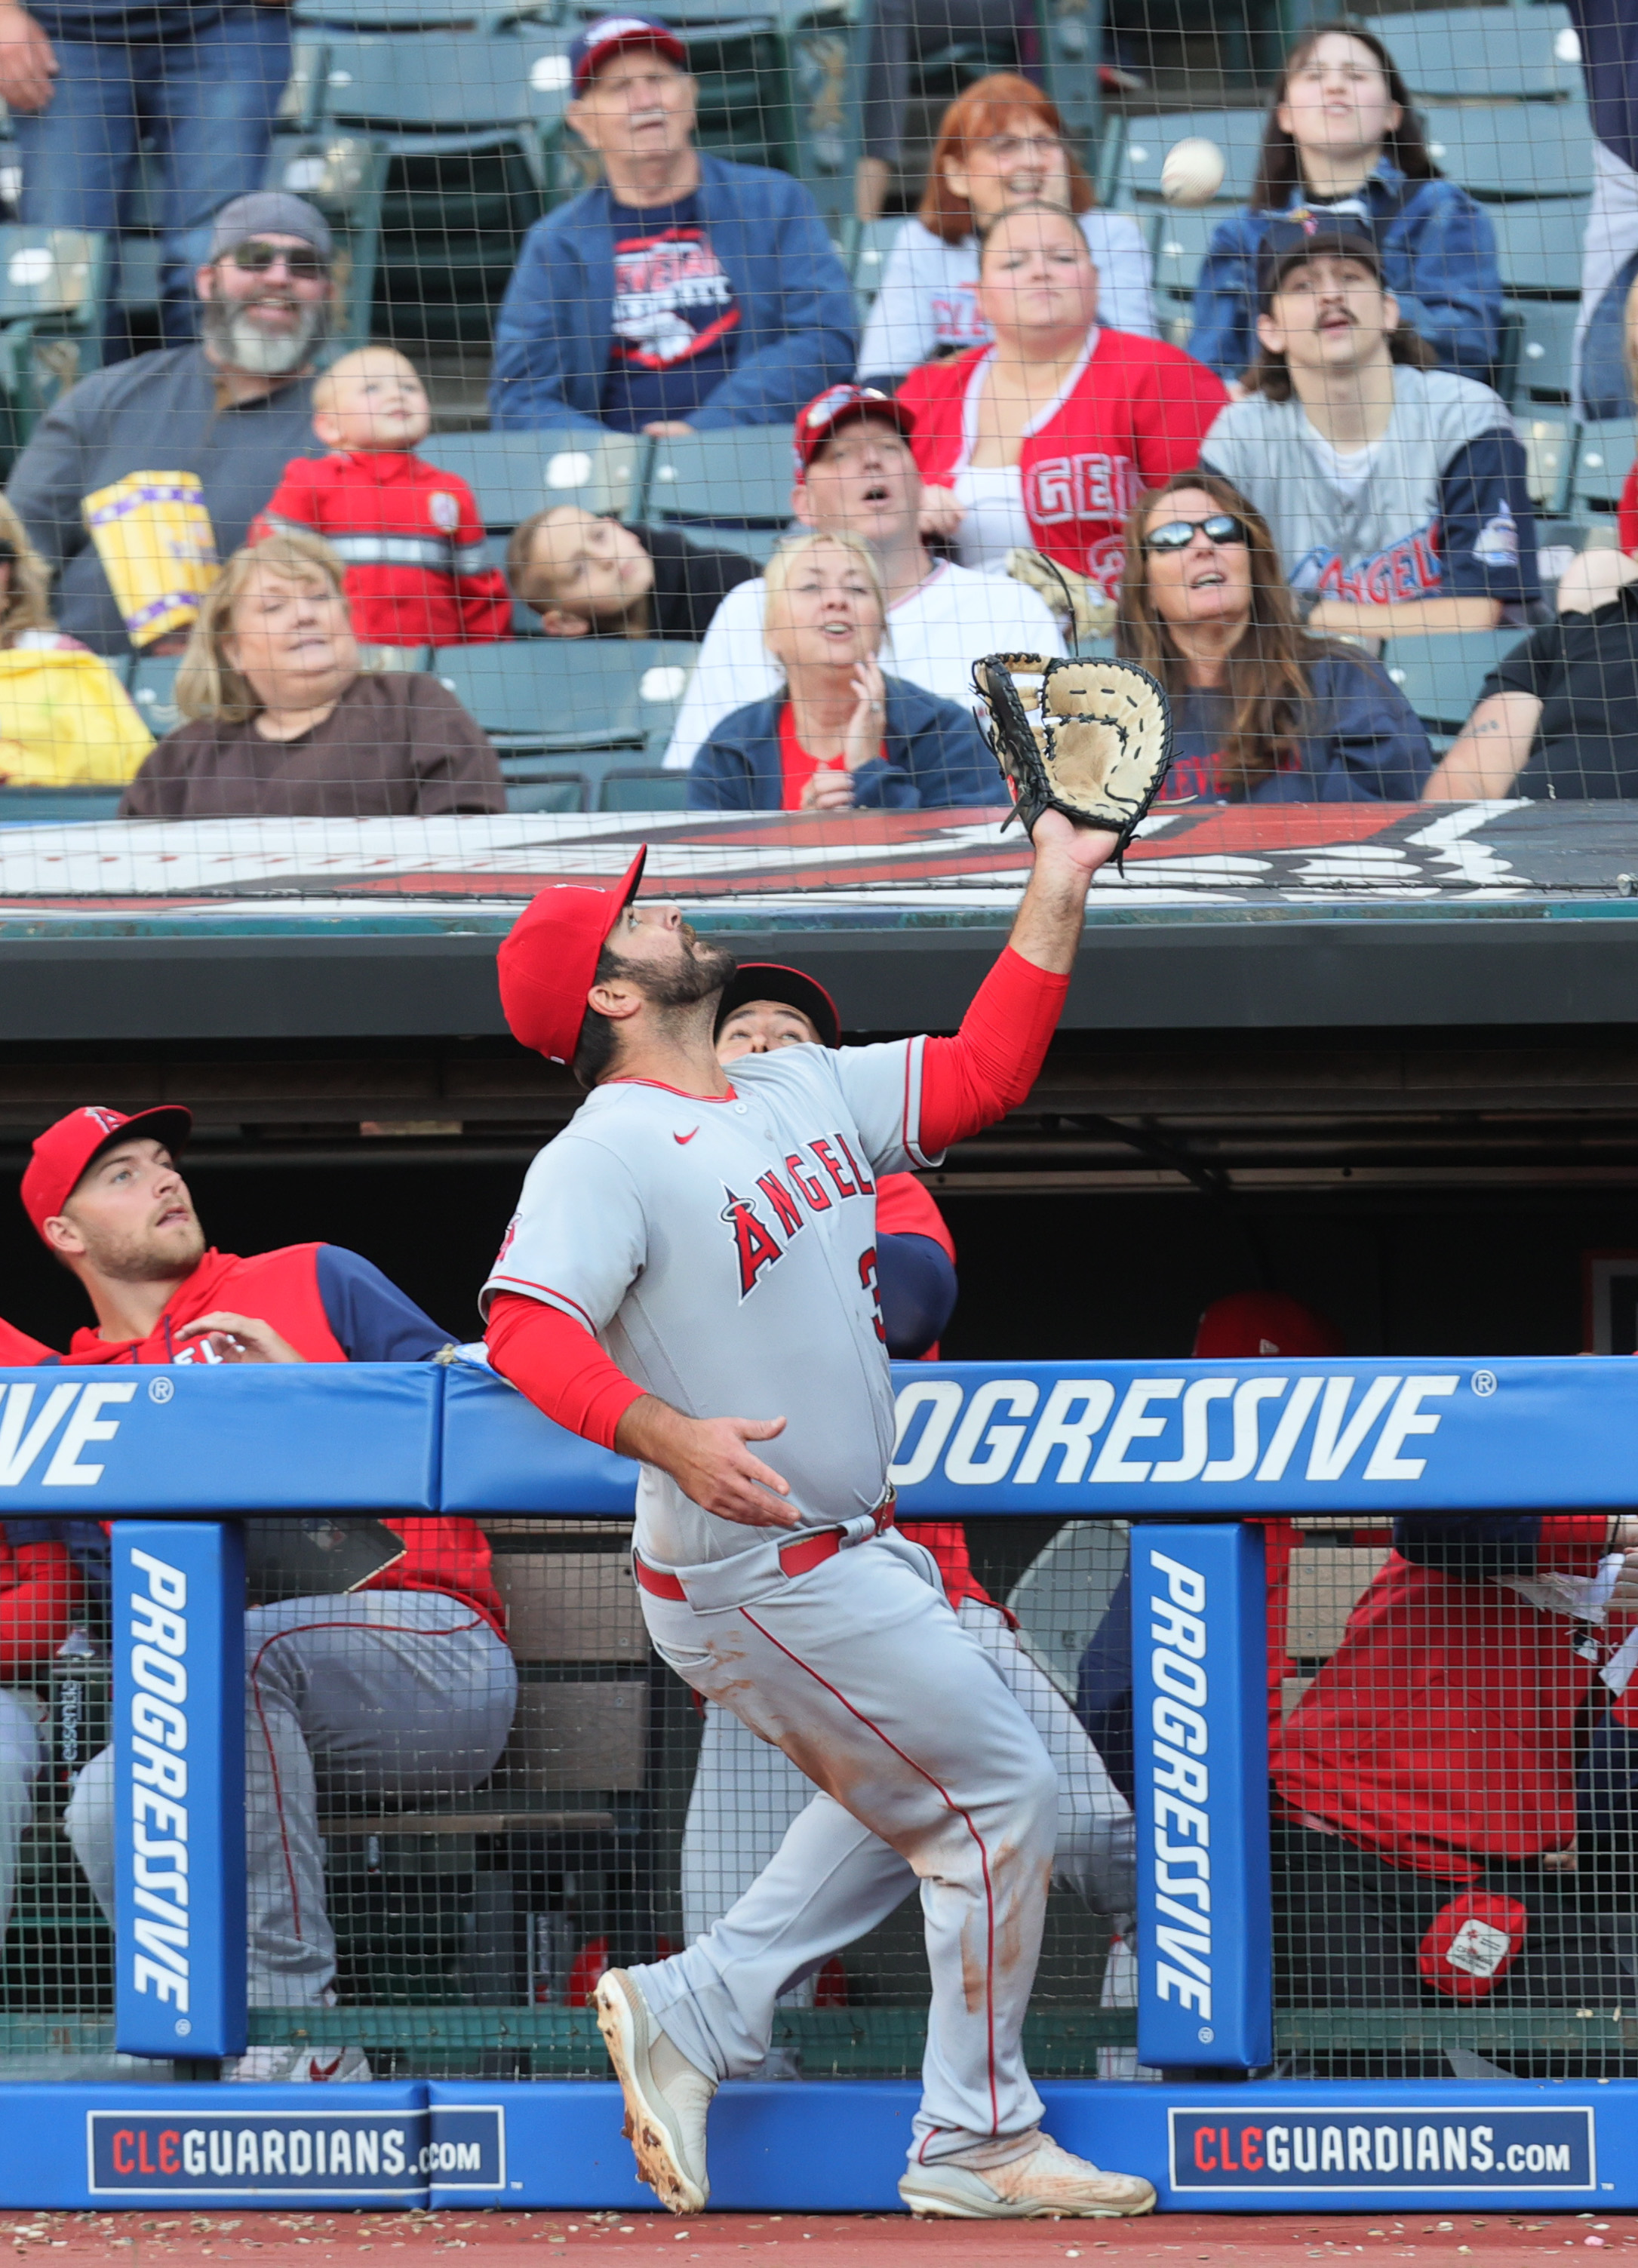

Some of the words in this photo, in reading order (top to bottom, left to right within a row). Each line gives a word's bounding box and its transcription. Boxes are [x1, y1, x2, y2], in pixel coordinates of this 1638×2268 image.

[718, 1131, 877, 1307] ANGEL
[0, 1381, 139, 1486] VE
[887, 1375, 1461, 1485] OGRESSIVE
[131, 1547, 189, 2014] PROGRESSIVE
[1150, 1549, 1212, 2021] PROGRESSIVE
[1194, 2125, 1570, 2173] CLEGUARDIANS.COM
